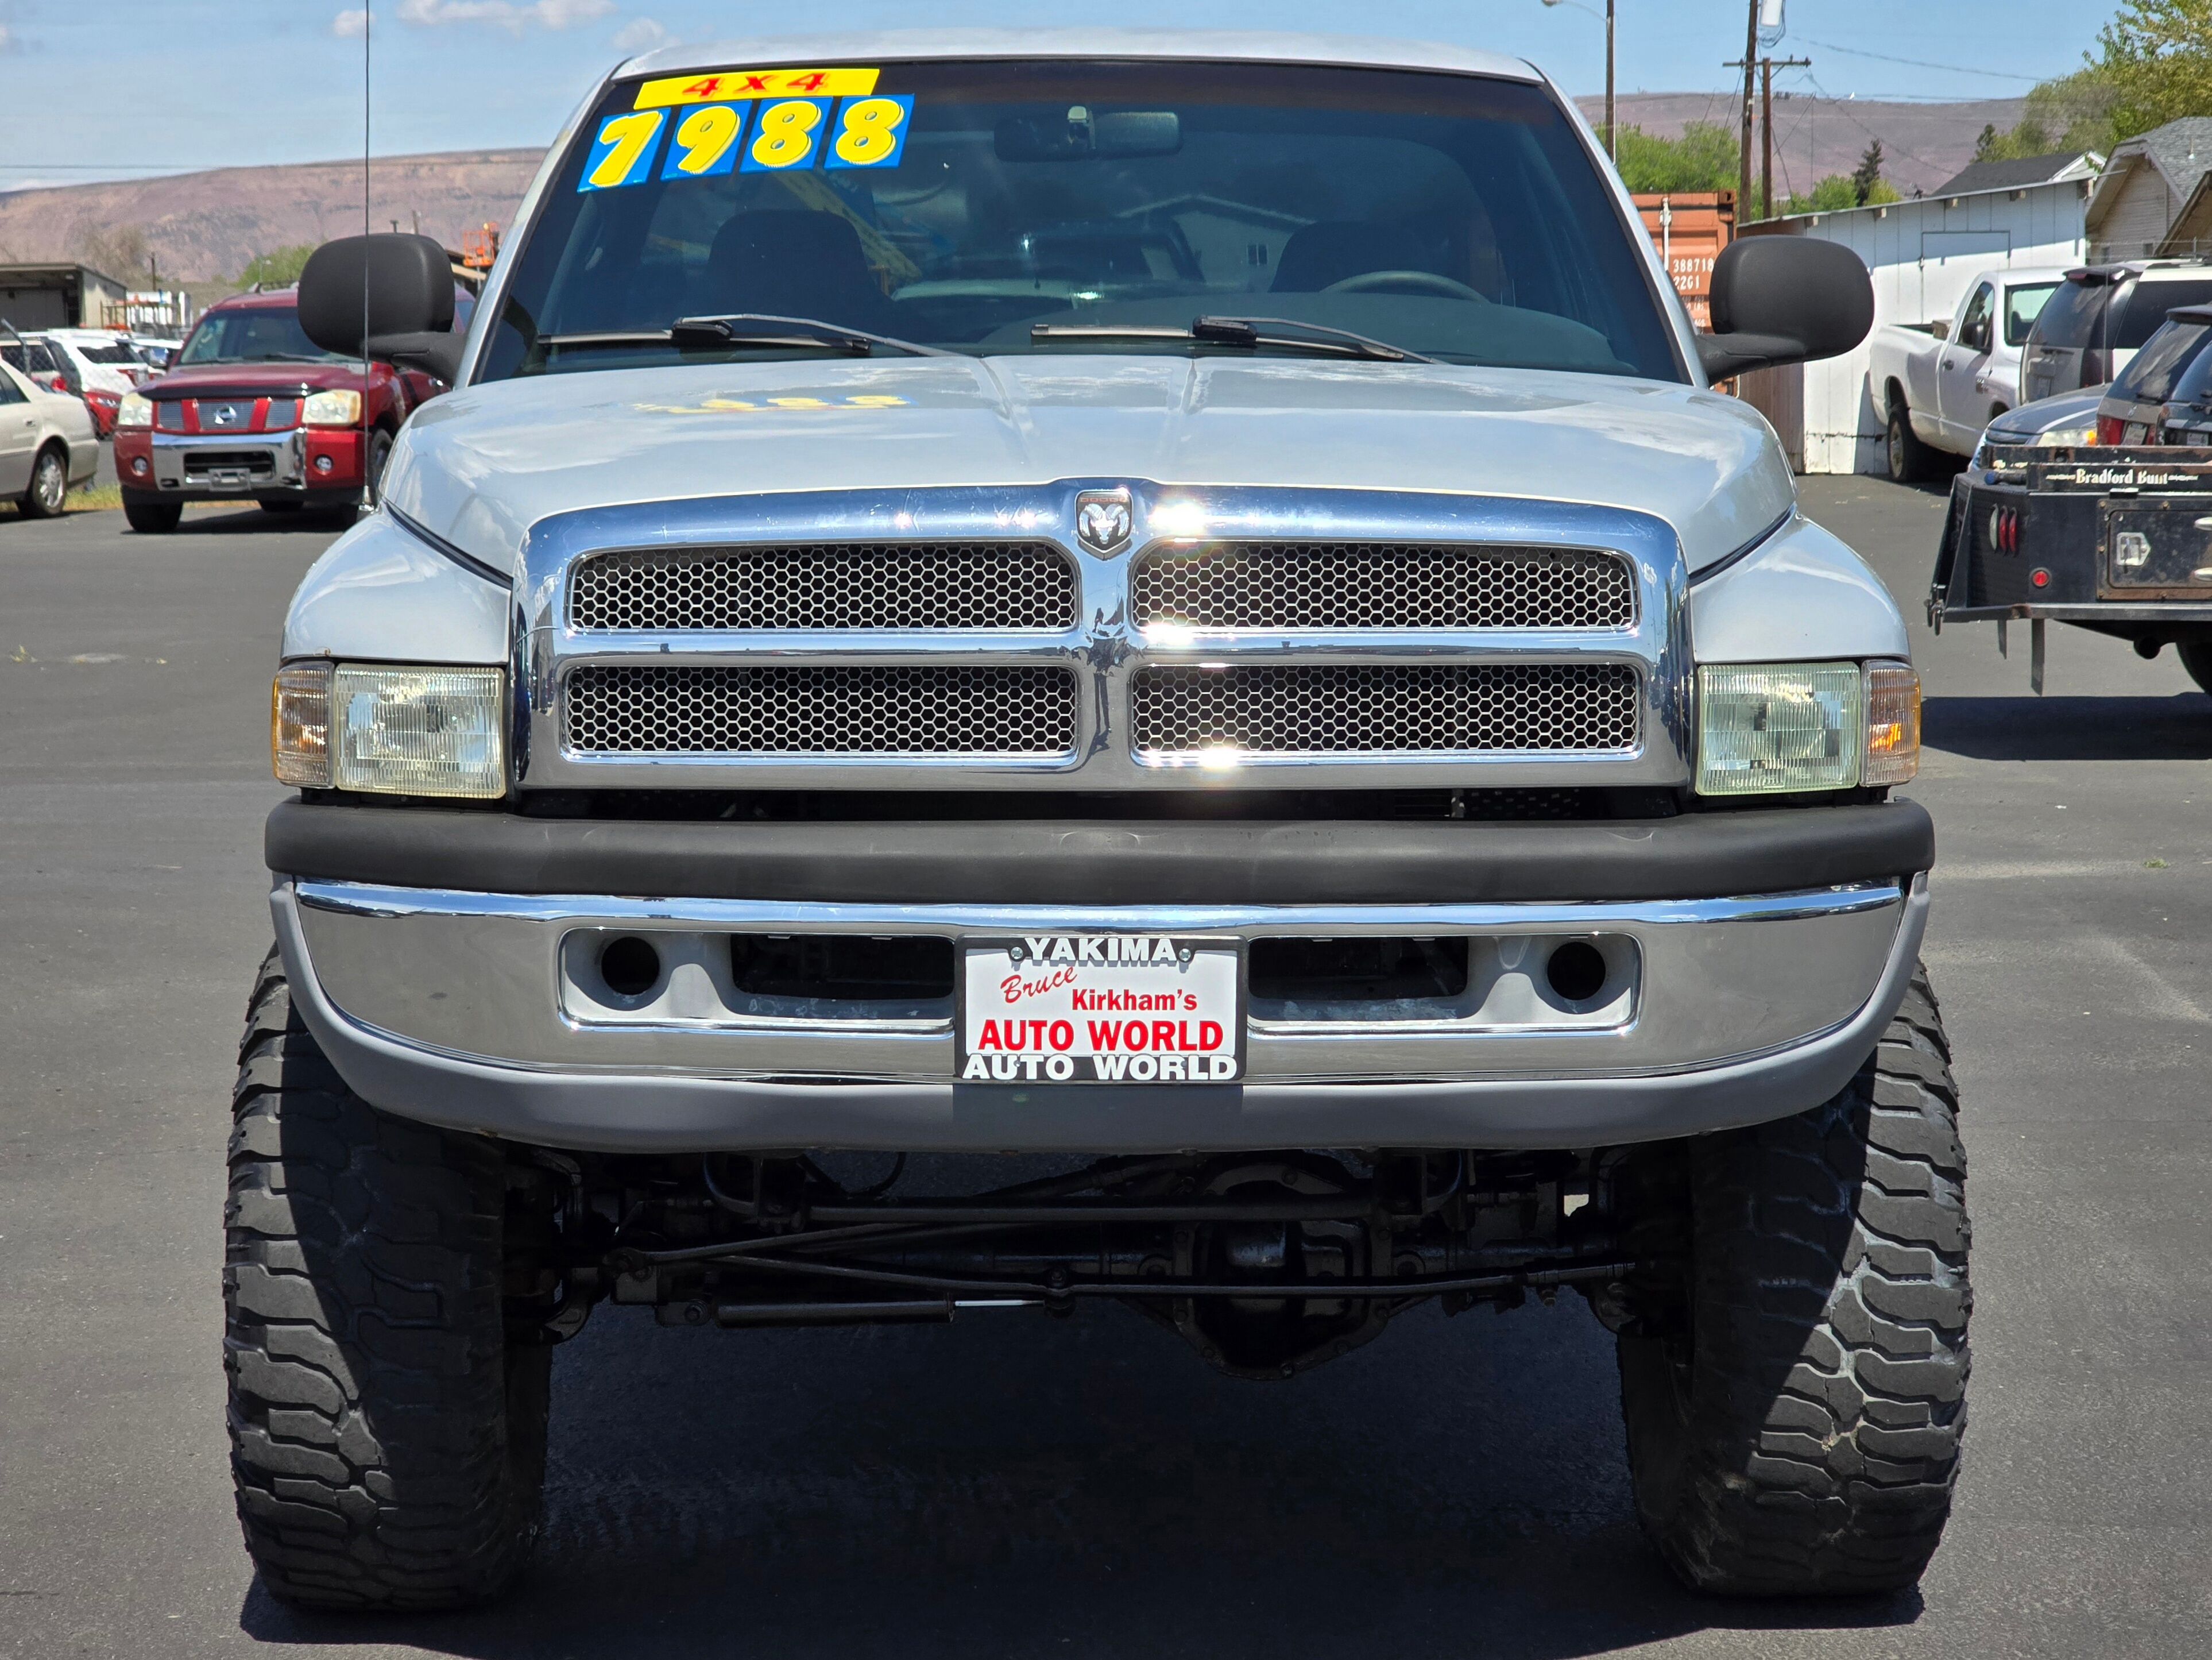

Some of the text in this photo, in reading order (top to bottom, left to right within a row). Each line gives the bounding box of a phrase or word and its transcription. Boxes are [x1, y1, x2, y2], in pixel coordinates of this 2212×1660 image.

[589, 99, 904, 187] 7988
[2075, 468, 2133, 484] Bradford
[1024, 937, 1178, 962] YAKIMA
[1000, 967, 1077, 1003] Bruce
[1072, 989, 1198, 1011] Kirkham's
[978, 1019, 1224, 1051] AUTO WORLD
[961, 1054, 1238, 1080] AUTO WORLD
